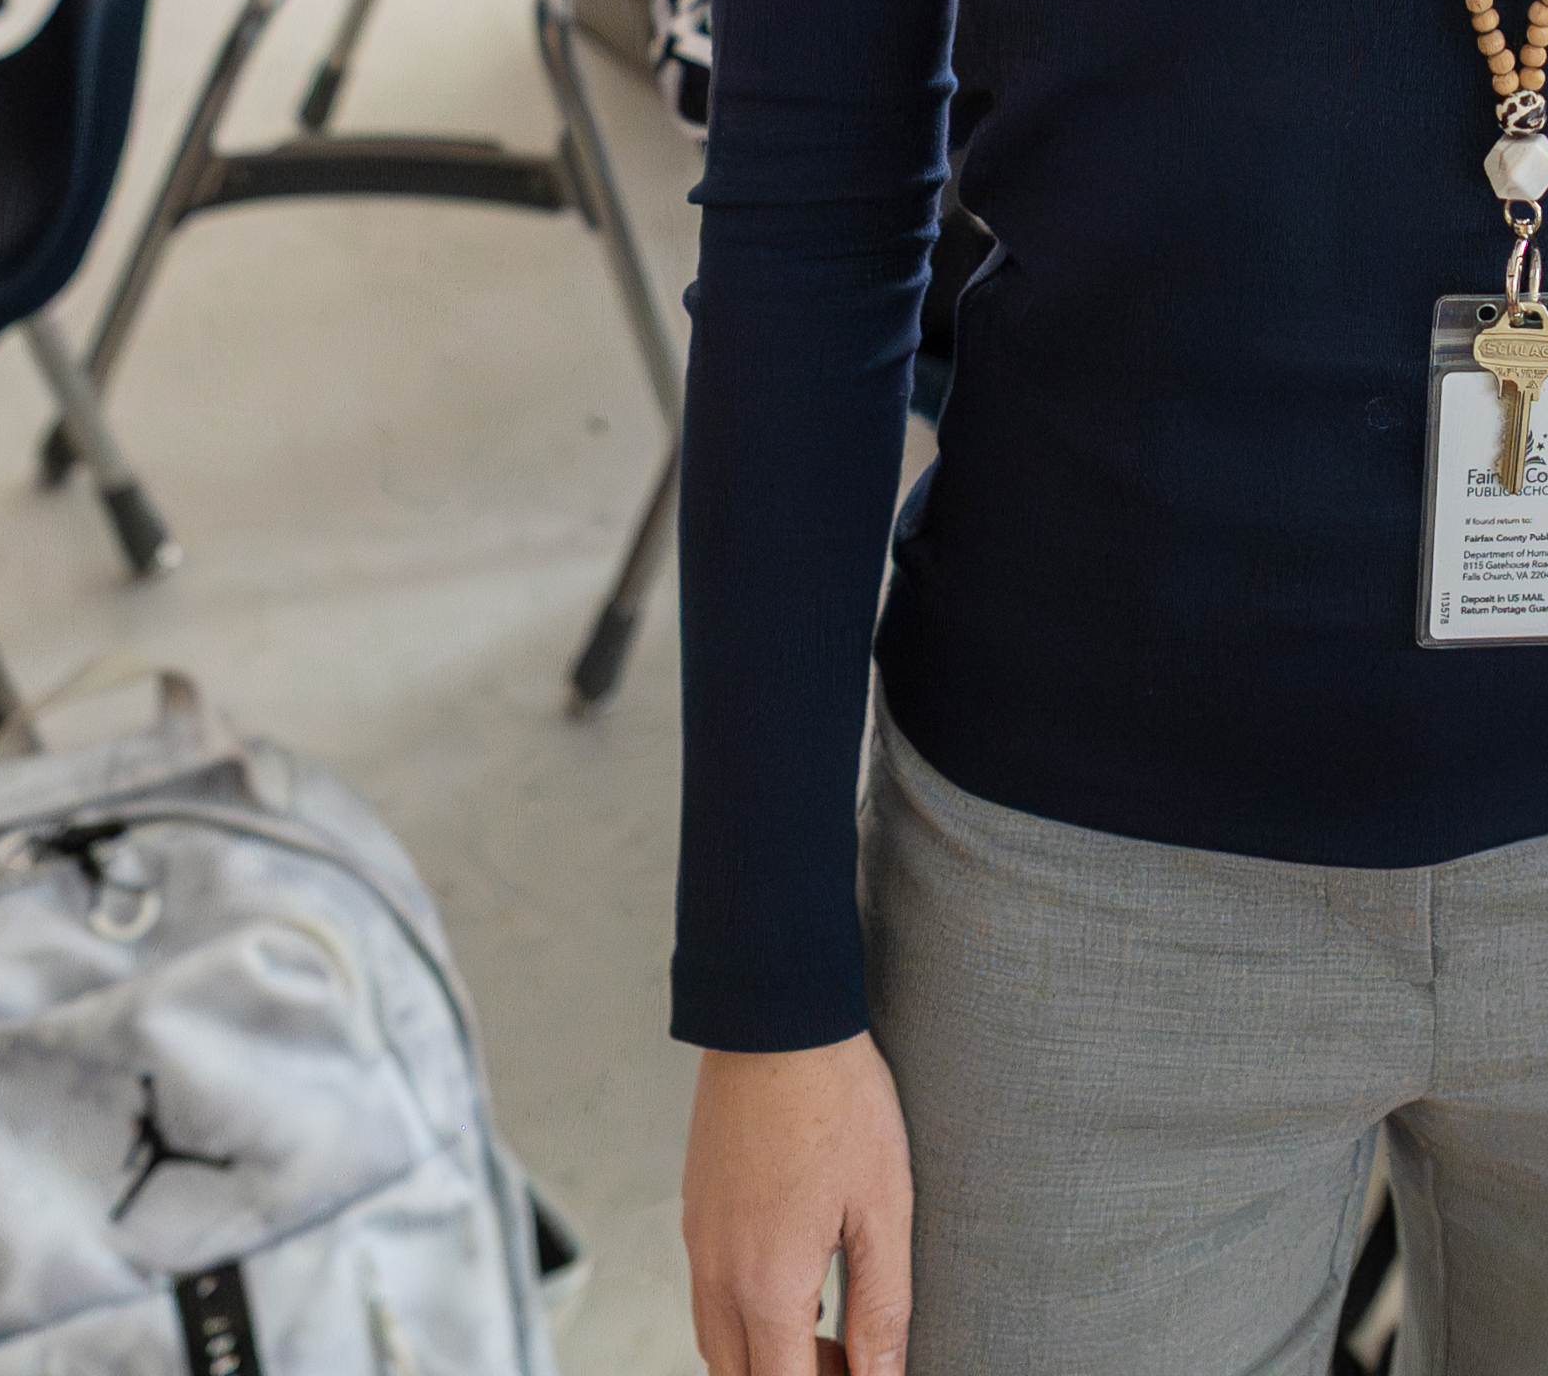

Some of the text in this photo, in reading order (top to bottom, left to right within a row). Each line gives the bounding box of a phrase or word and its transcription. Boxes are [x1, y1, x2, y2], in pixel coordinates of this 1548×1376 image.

[1467, 468, 1504, 485] Fair
[1465, 517, 1471, 525] If
[1472, 517, 1495, 525] found
[1464, 534, 1494, 543] Fairfax
[1496, 533, 1527, 544] County
[1463, 550, 1514, 560] Department
[1516, 548, 1525, 558] of
[1463, 561, 1484, 570] 8115
[1485, 559, 1530, 569] Gatehouse
[1462, 572, 1481, 581] Falls
[1482, 571, 1514, 581] Church,
[1516, 571, 1529, 580] VA
[1461, 592, 1545, 605] Deposit in US MAIL
[1439, 591, 1450, 625] 113578
[1461, 606, 1490, 615] Return
[1491, 605, 1527, 616] Postage
